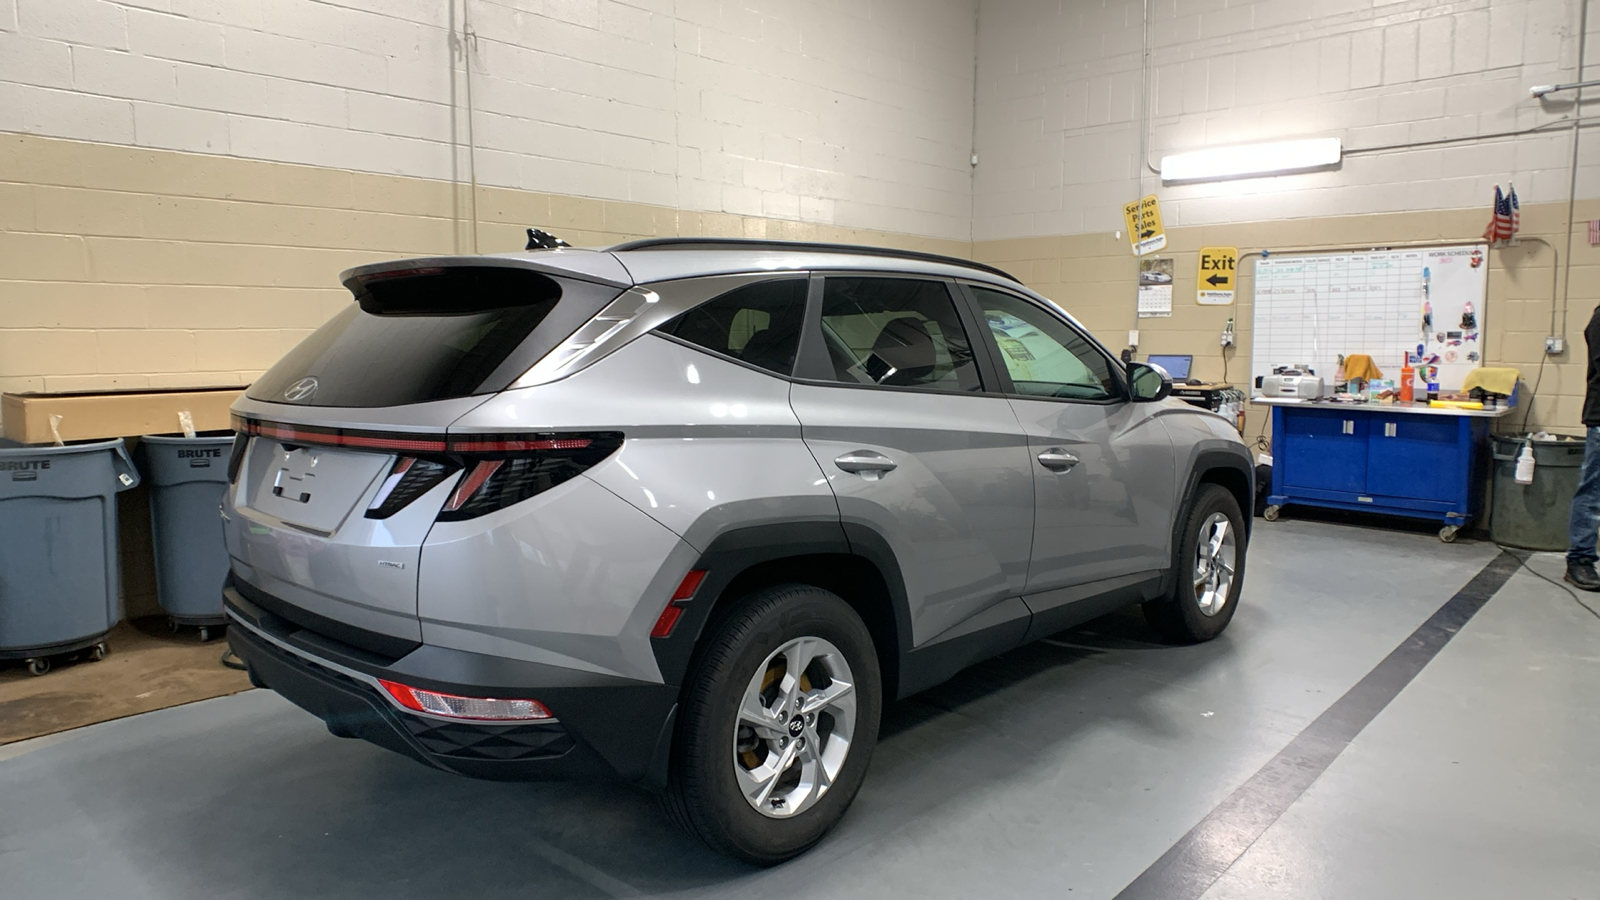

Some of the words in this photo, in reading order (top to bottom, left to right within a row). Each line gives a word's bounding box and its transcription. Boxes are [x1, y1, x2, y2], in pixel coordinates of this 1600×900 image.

[1134, 219, 1156, 232] Sales
[1201, 254, 1235, 270] Exit
[178, 449, 221, 458] BRUTE
[0, 460, 51, 471] BRUTE
